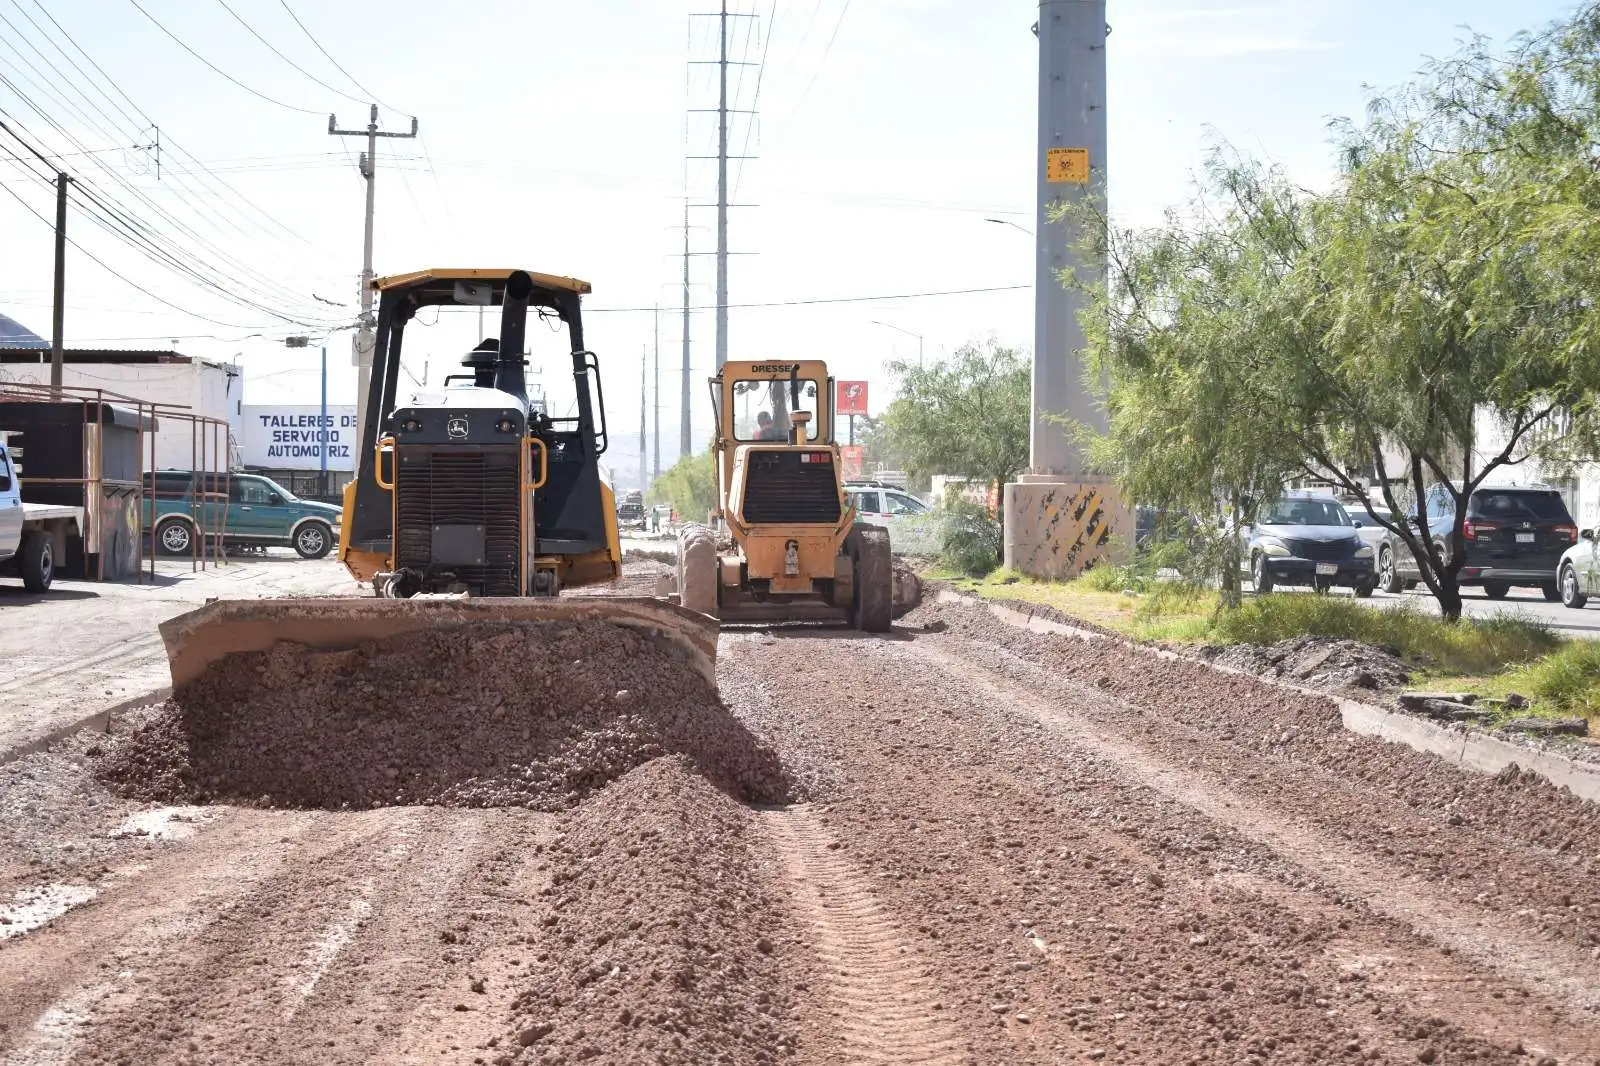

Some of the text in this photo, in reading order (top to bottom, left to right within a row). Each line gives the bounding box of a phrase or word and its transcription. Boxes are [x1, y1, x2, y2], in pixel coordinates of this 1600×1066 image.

[751, 364, 792, 373] DRESSE
[260, 415, 357, 427] TALLERES DE
[272, 430, 339, 442] SERVICIO
